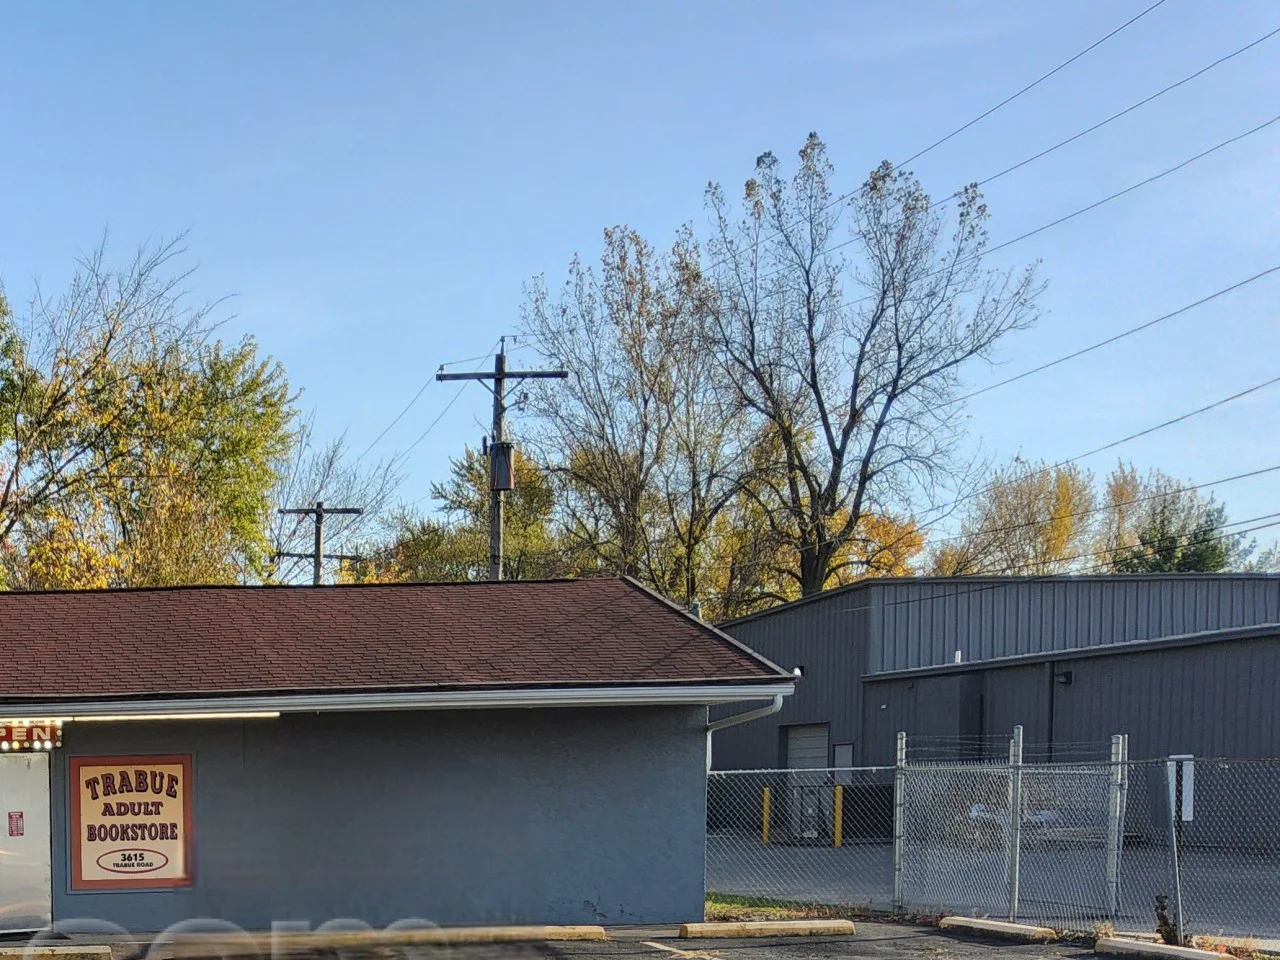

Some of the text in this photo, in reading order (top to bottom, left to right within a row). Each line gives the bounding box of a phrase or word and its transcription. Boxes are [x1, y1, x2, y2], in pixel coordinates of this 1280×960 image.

[84, 769, 179, 800] TRABUE
[101, 801, 164, 816] ADULT
[86, 822, 178, 842] BOOKSTORE
[120, 853, 145, 862] 3615
